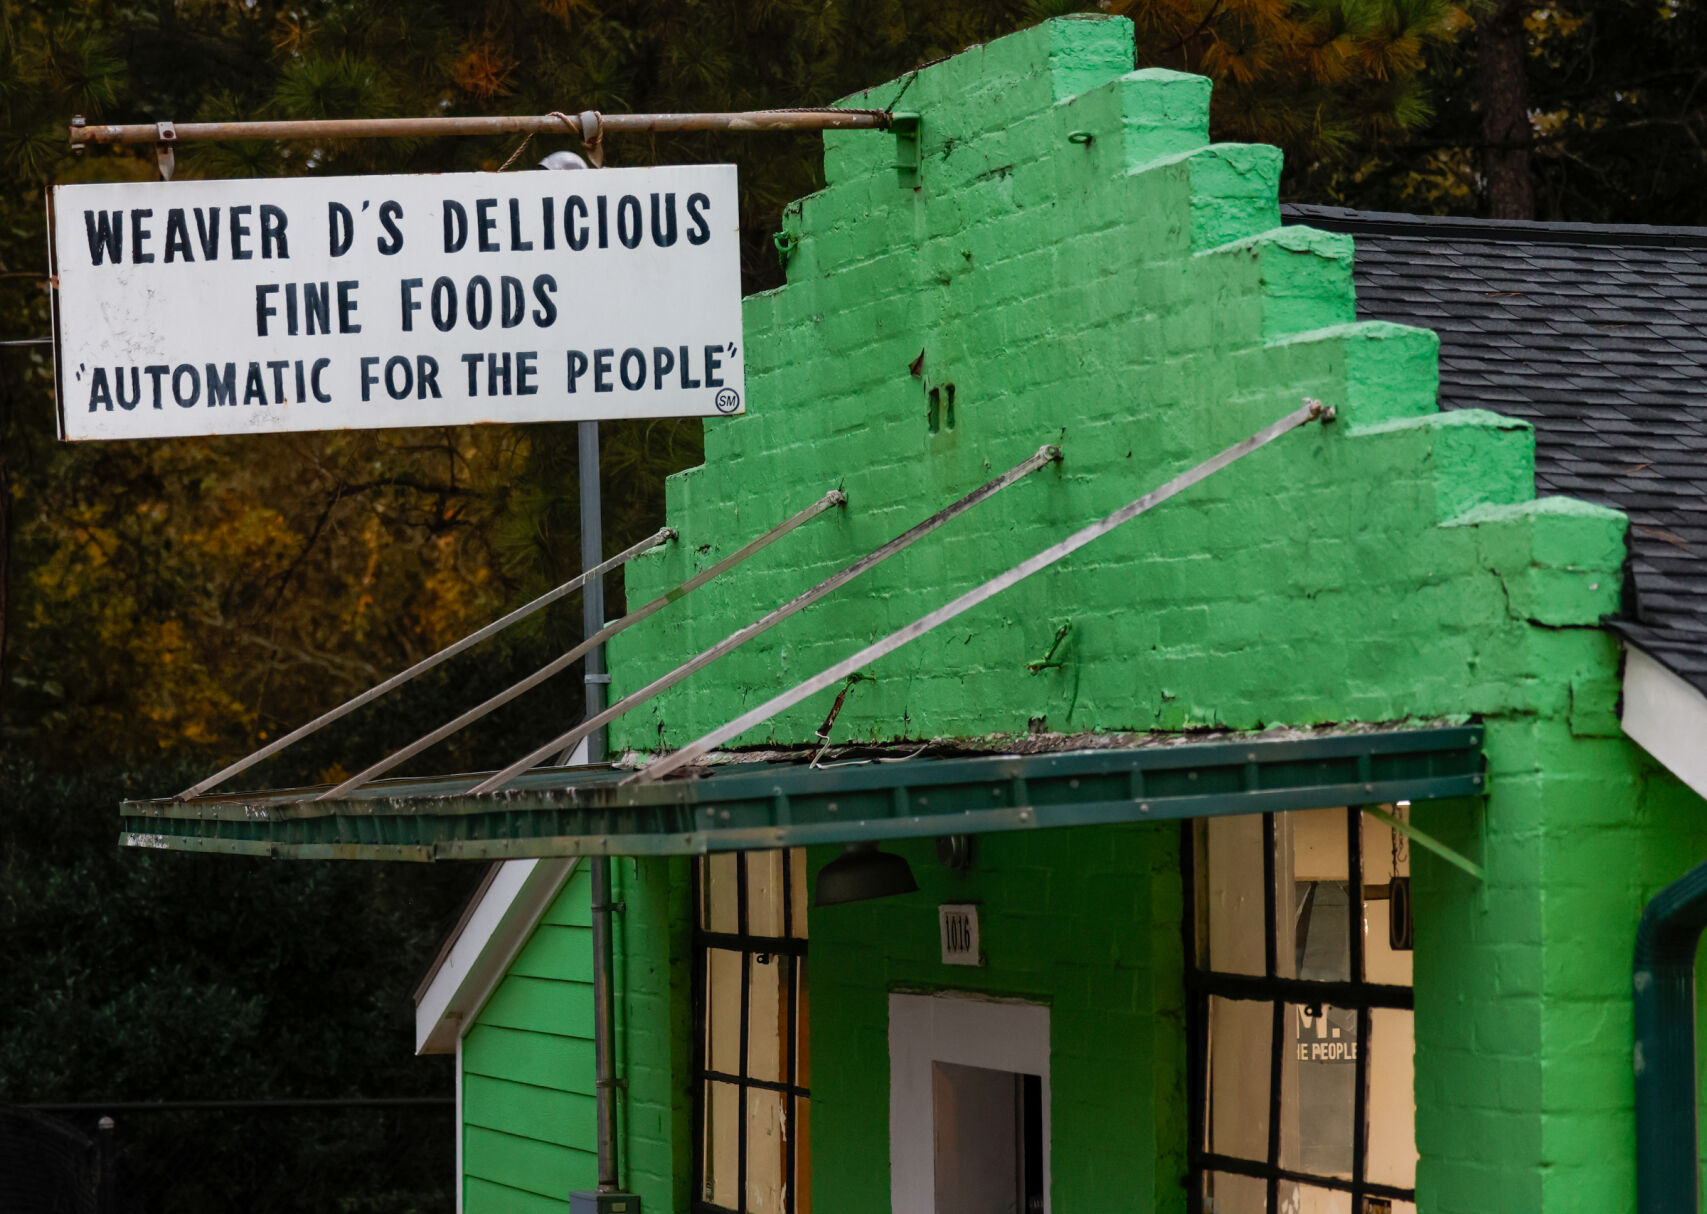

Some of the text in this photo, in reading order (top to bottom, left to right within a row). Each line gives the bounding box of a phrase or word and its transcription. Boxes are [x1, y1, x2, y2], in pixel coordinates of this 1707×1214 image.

[84, 193, 710, 266] WEAVER D'S DELICIOUS
[256, 274, 557, 336] FINE FOODS
[76, 342, 738, 413] "AUTOMATIC FOR THE PEOPLE"
[718, 395, 736, 407] SM
[945, 915, 971, 952] 1016
[1312, 1042, 1358, 1060] PEOPLE
